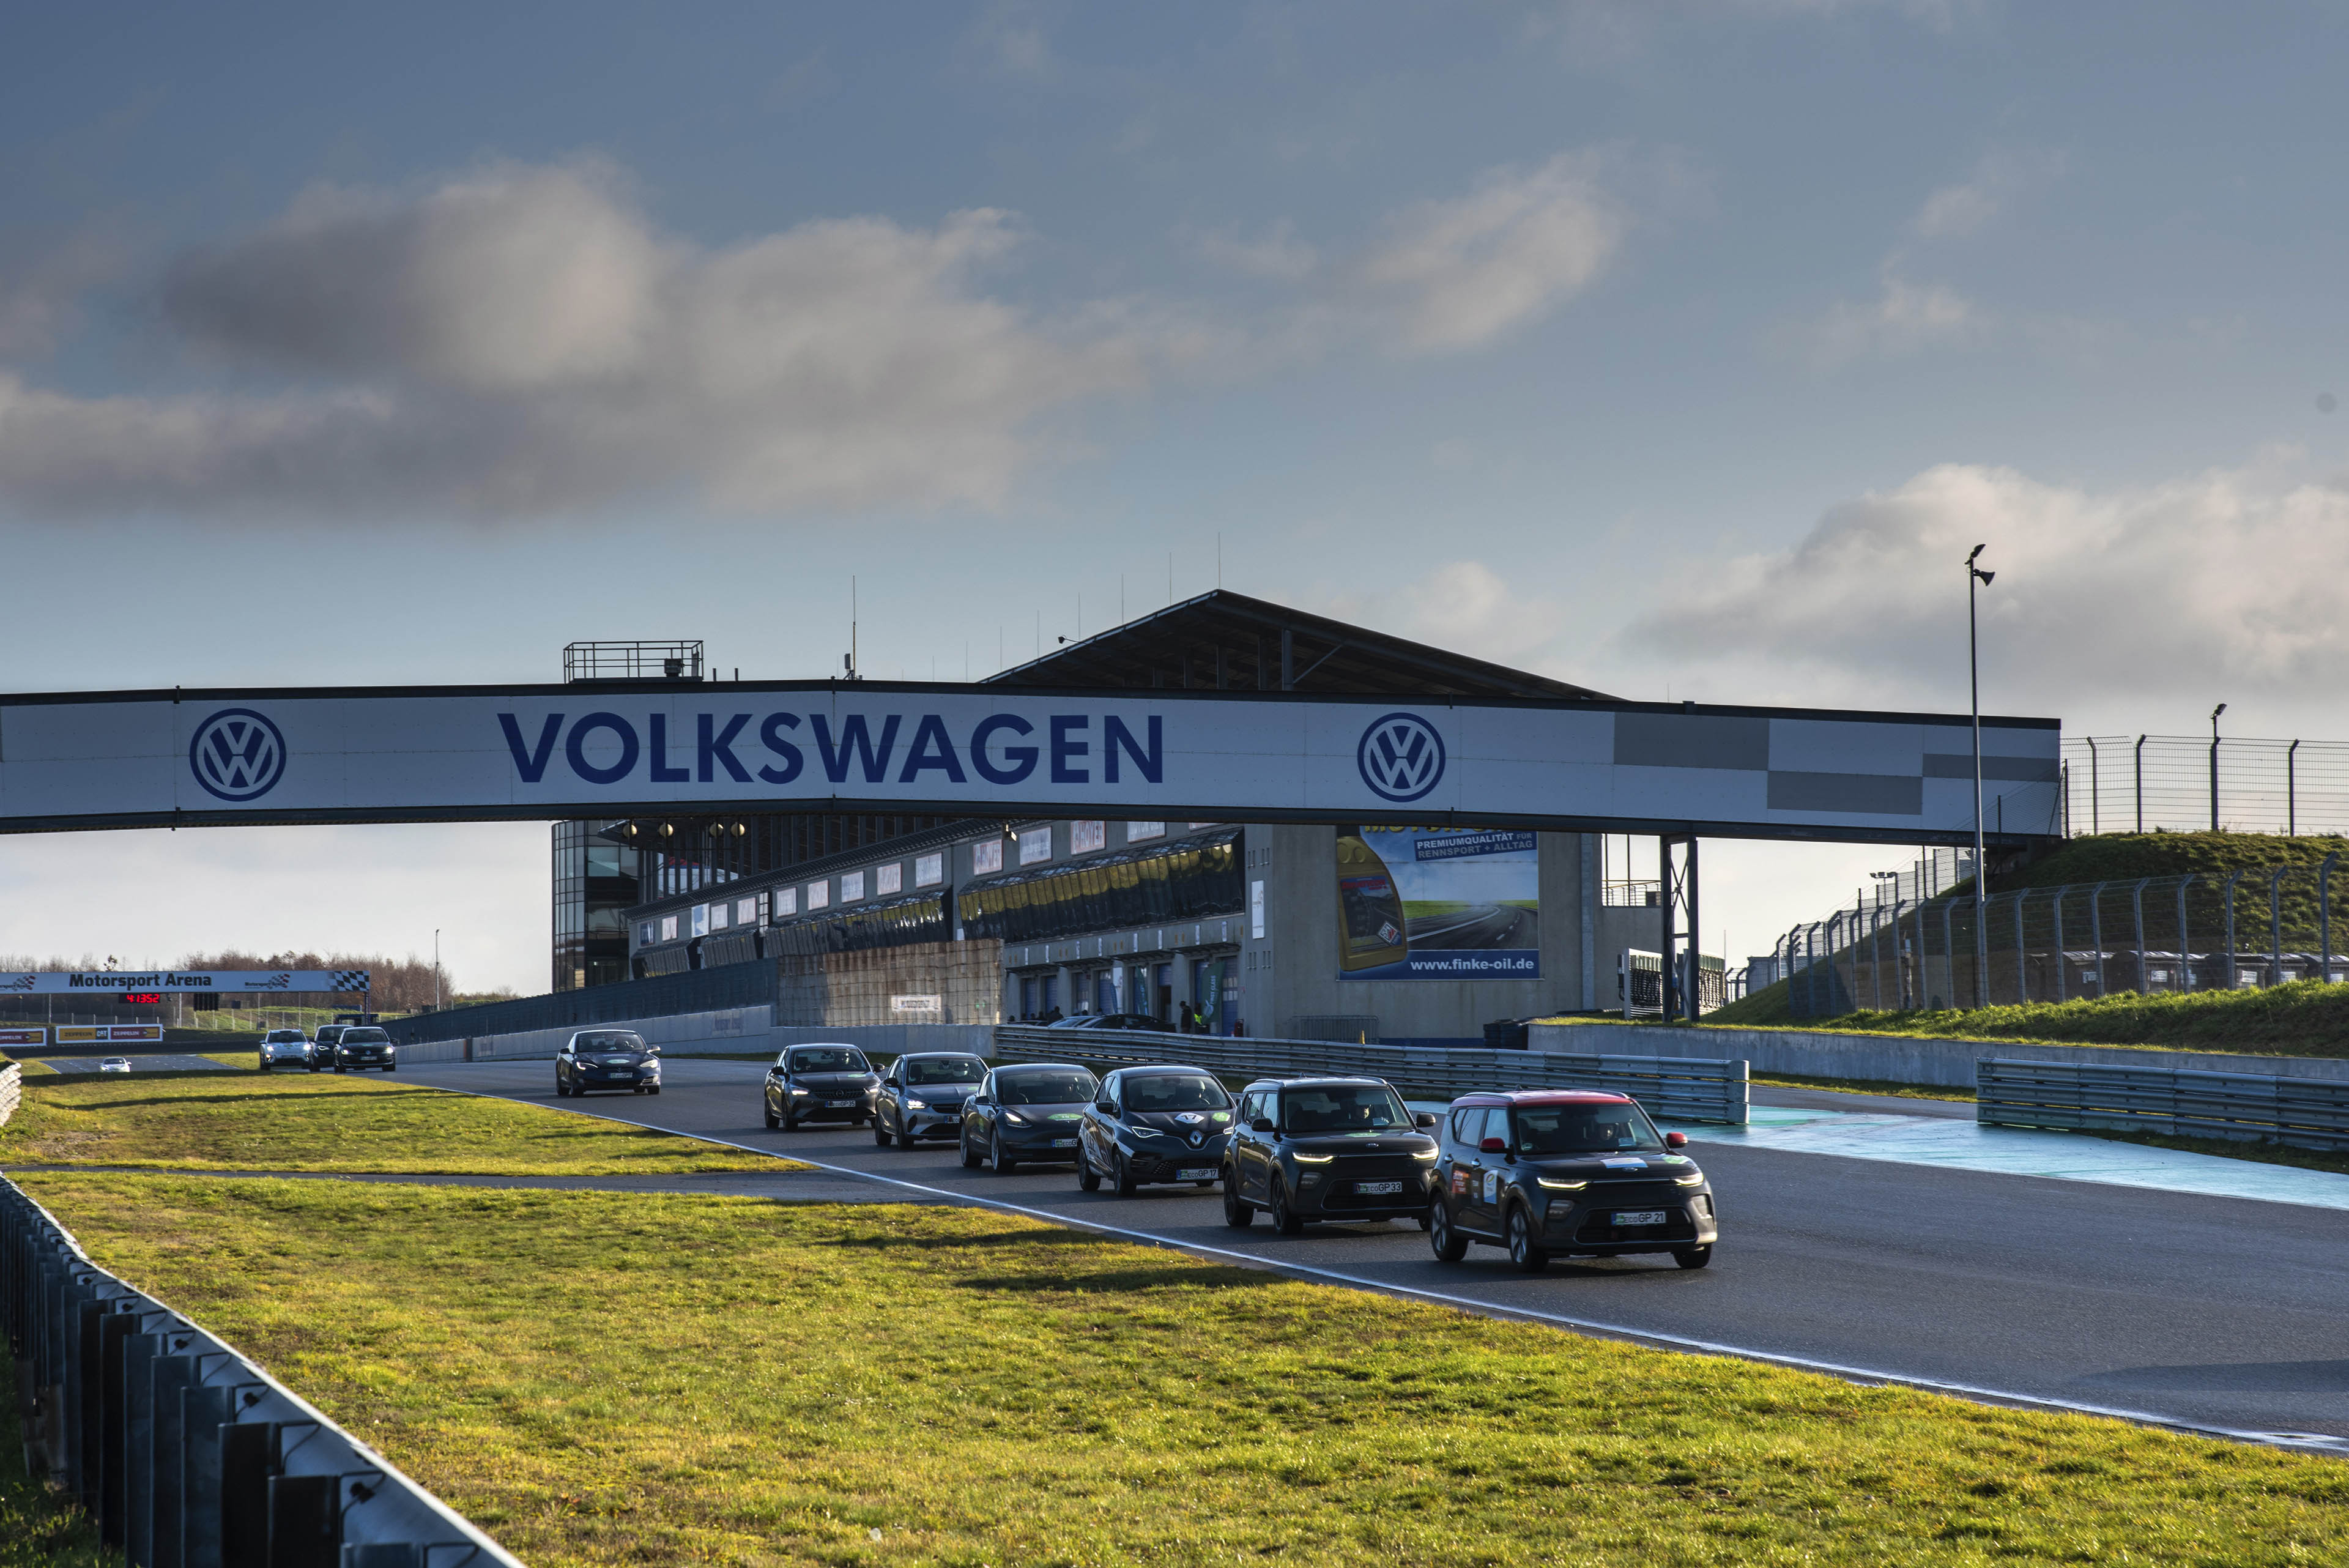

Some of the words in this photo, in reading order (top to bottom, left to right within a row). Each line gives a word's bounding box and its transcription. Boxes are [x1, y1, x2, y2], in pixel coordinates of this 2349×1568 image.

[191, 710, 284, 799] VW
[496, 712, 1163, 785] VOLKSWAGEN
[1360, 715, 1444, 800] VW
[1416, 833, 1514, 850] PREMIUMQUALITÄT
[1417, 845, 1481, 859] RENNSPORT
[1494, 840, 1533, 852] ALLTAG
[1410, 958, 1534, 970] www.finke-oil.de
[69, 973, 160, 990] Motorsport
[165, 973, 212, 986] Arena
